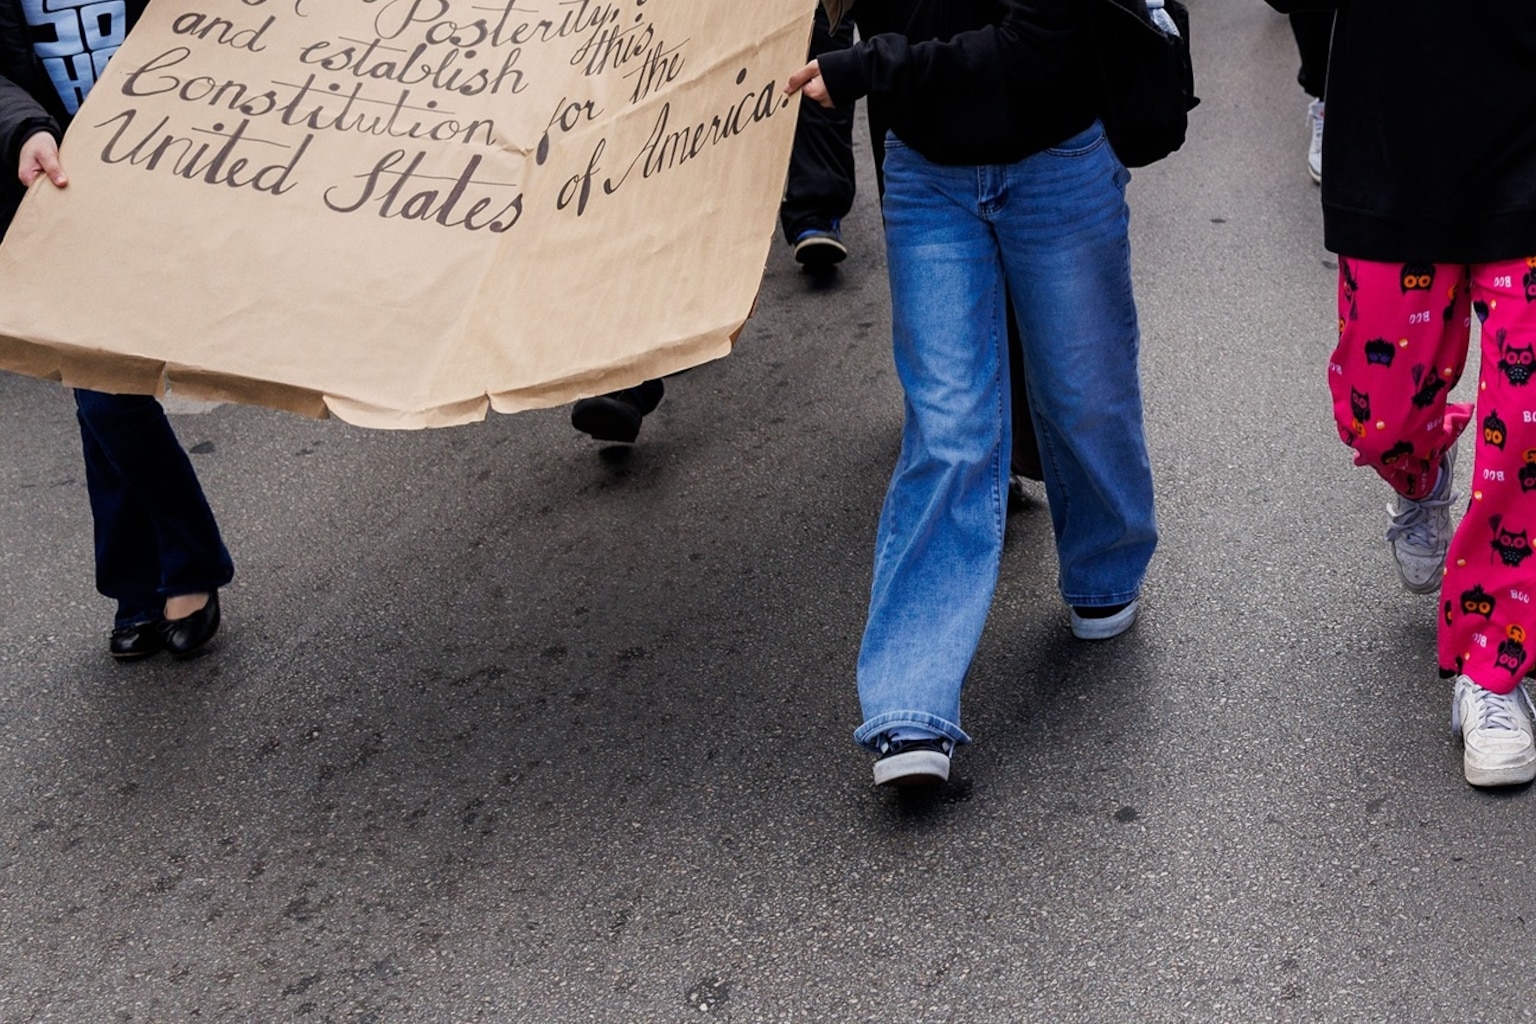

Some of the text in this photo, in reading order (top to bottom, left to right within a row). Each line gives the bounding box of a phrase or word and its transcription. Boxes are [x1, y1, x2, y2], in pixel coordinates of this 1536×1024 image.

[172, 12, 655, 97] and establish this
[121, 36, 692, 167] Constitution for the
[93, 108, 299, 196] United
[323, 148, 525, 233] States
[556, 137, 606, 217] of
[1493, 275, 1513, 288] BOO
[1483, 468, 1505, 481] BOO
[1510, 589, 1530, 604] BOO
